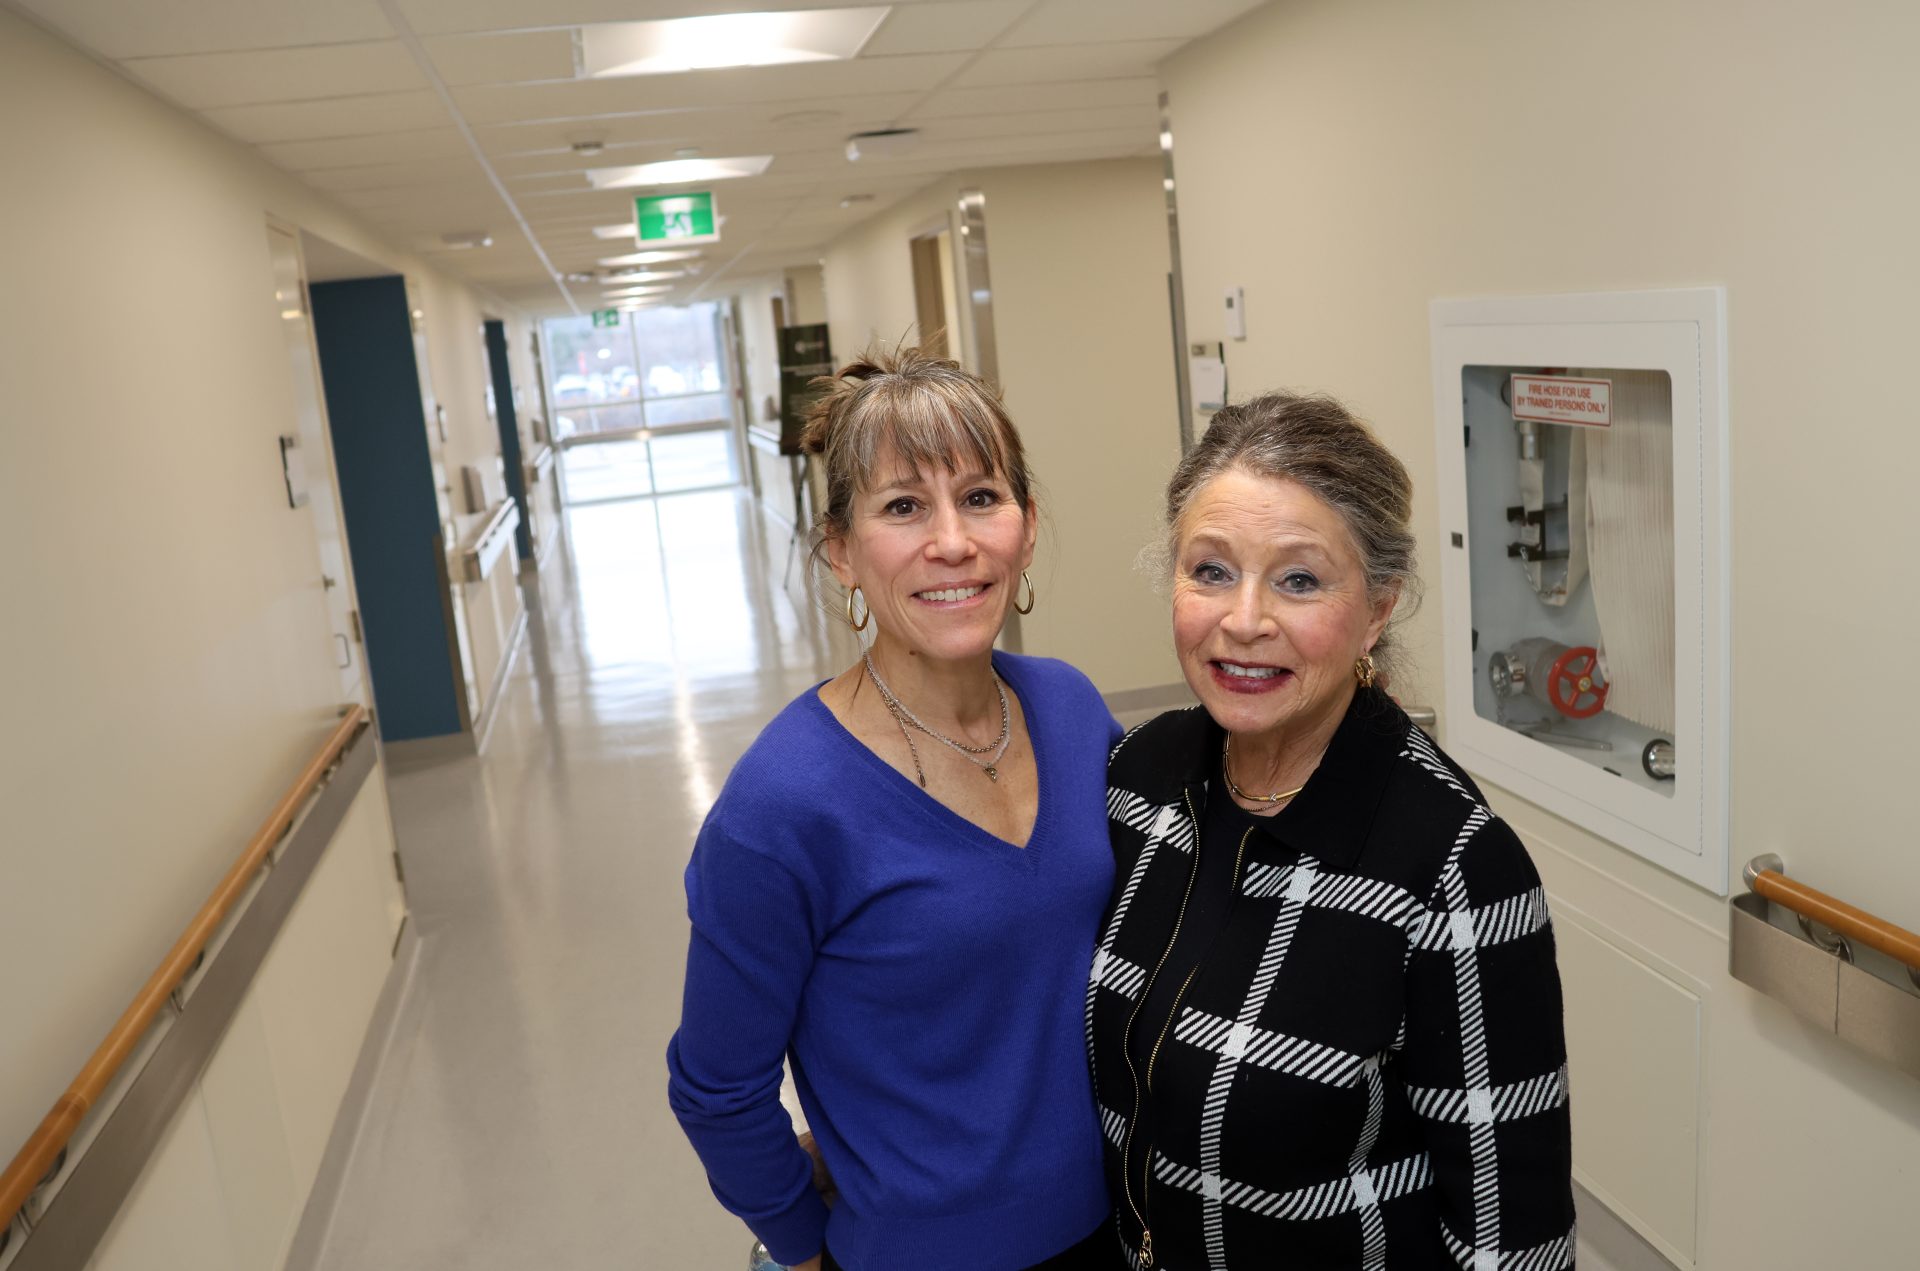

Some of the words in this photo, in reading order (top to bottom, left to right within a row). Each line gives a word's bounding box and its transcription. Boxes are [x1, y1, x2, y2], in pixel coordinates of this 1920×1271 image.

[1528, 384, 1542, 395] FIRE
[1543, 385, 1560, 396] HOSE
[1562, 386, 1576, 397] FOR
[1577, 387, 1591, 399] USE
[1517, 396, 1525, 405] BY
[1527, 396, 1553, 408] TRAINED
[1555, 399, 1586, 412] PERSONS
[1587, 401, 1606, 413] ONLY
